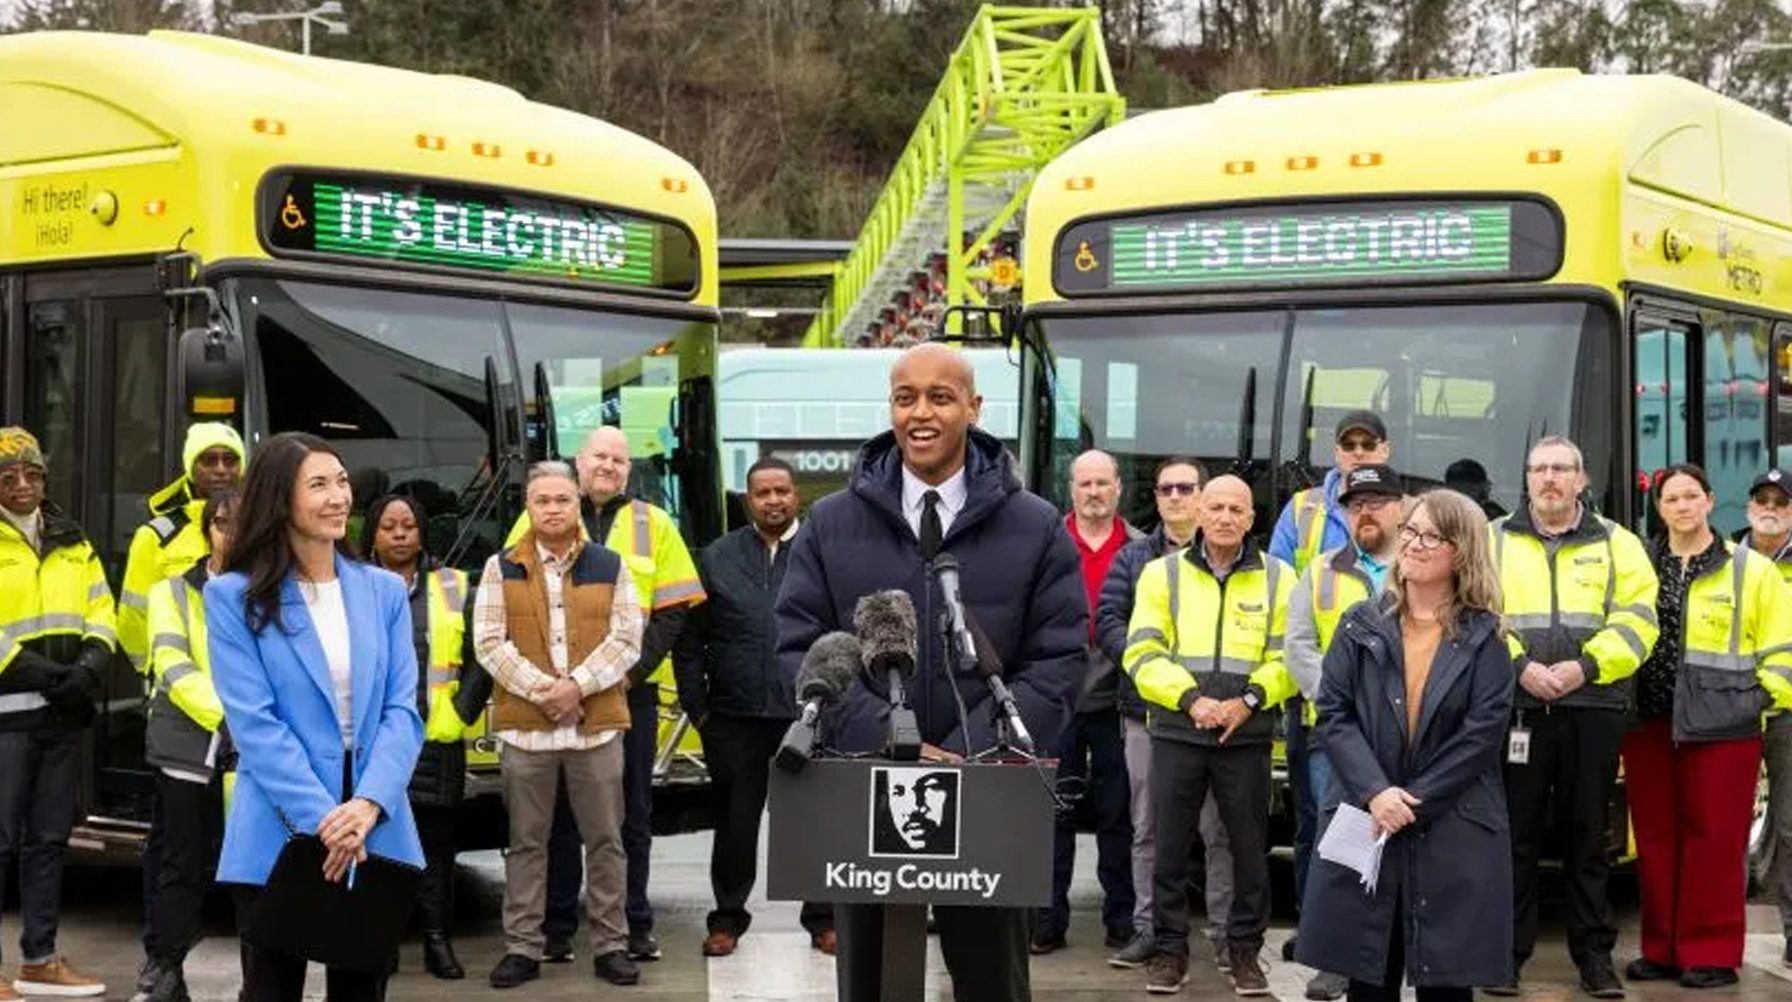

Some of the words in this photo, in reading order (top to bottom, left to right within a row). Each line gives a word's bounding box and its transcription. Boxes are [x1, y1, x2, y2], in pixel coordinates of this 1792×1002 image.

[44, 181, 88, 213] there!
[341, 190, 423, 247] IT'S
[433, 202, 627, 270] ELECTRIC
[1145, 221, 1230, 270] IT'S
[1242, 213, 1473, 265] ELECTRIC
[795, 450, 850, 472] 1001
[825, 862, 892, 895] King
[897, 863, 1002, 898] County
